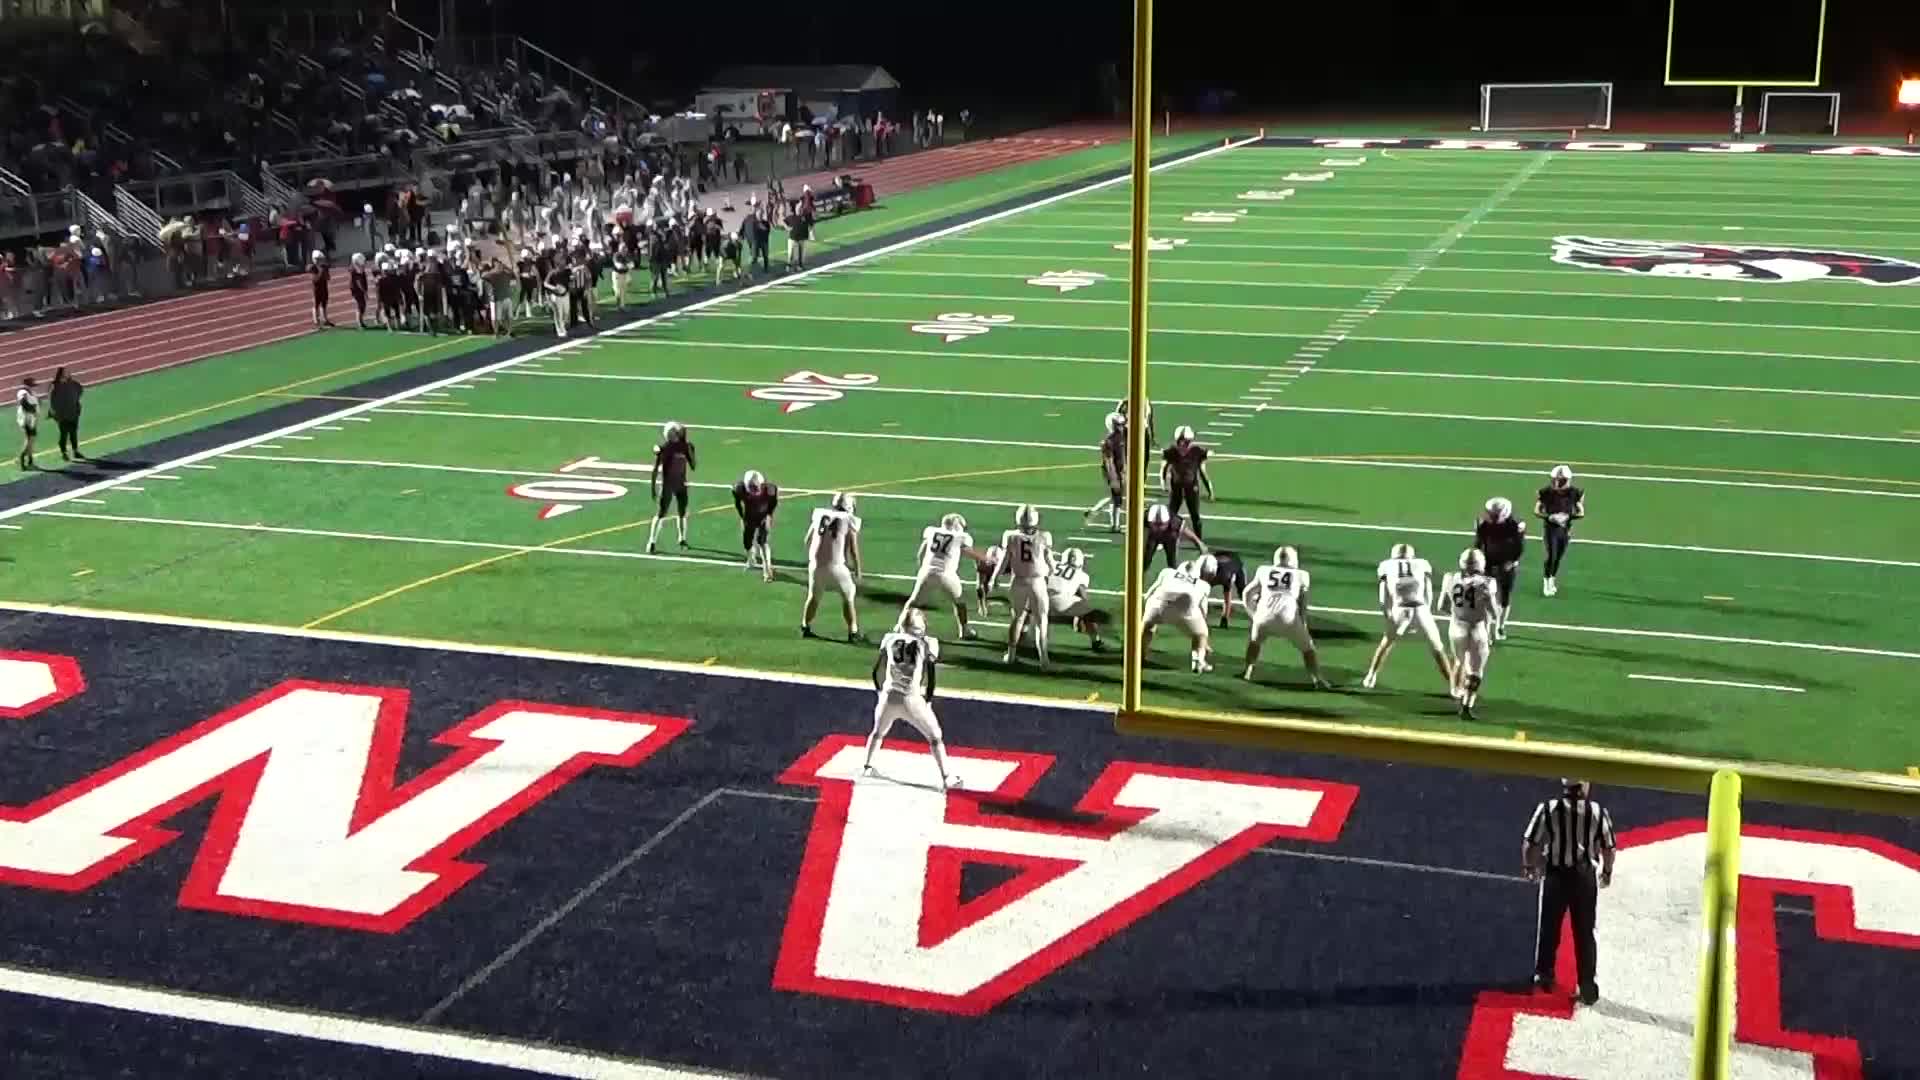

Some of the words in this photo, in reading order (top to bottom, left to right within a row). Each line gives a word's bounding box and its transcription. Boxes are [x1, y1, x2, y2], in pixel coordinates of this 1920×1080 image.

[911, 312, 1016, 335] 30
[748, 370, 879, 401] 20
[508, 456, 664, 501] 10
[1021, 541, 1032, 561] 6
[1054, 562, 1075, 580] 50
[1398, 560, 1414, 577] 11
[1267, 570, 1293, 591] 54
[1452, 583, 1476, 609] 24
